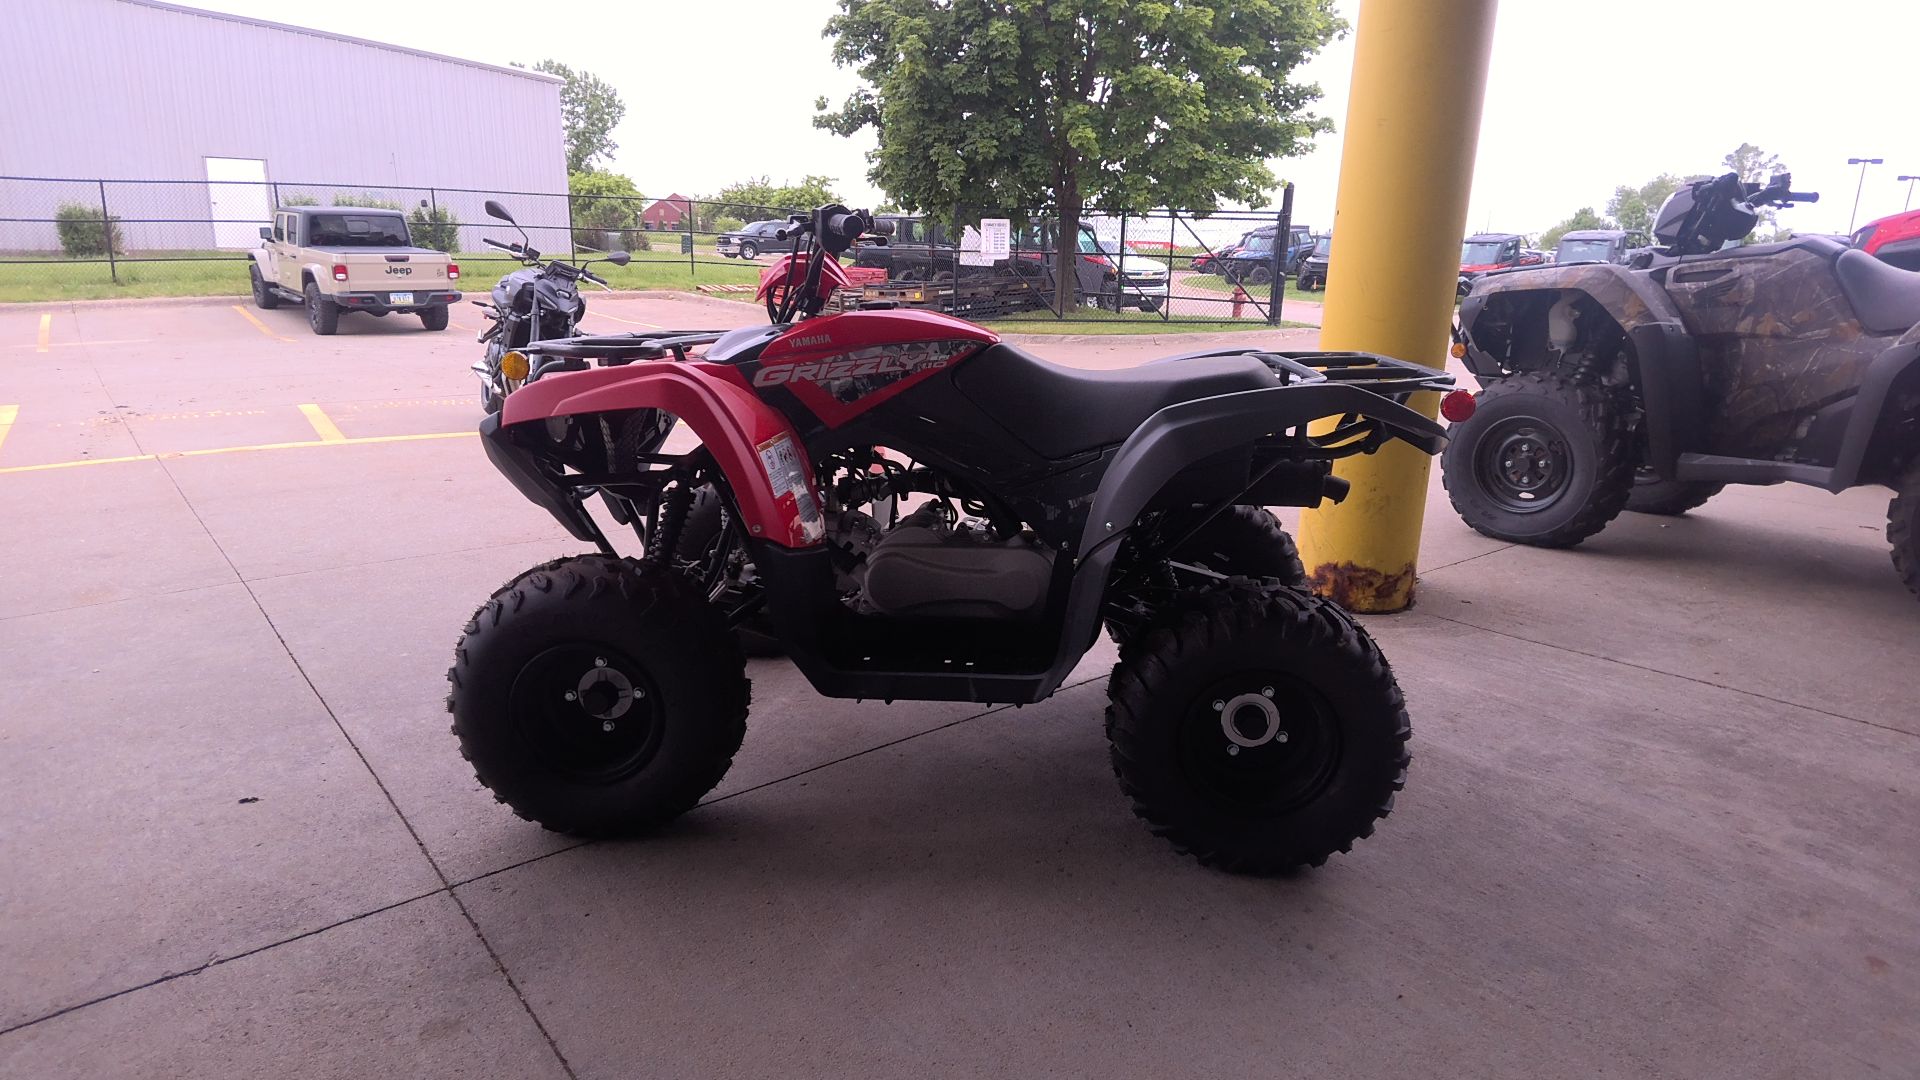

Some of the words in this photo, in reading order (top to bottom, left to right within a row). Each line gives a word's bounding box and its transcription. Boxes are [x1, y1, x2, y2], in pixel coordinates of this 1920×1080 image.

[385, 265, 412, 275] Jeep
[789, 334, 832, 348] YAMAHA
[752, 353, 928, 388] GRIZZLY
